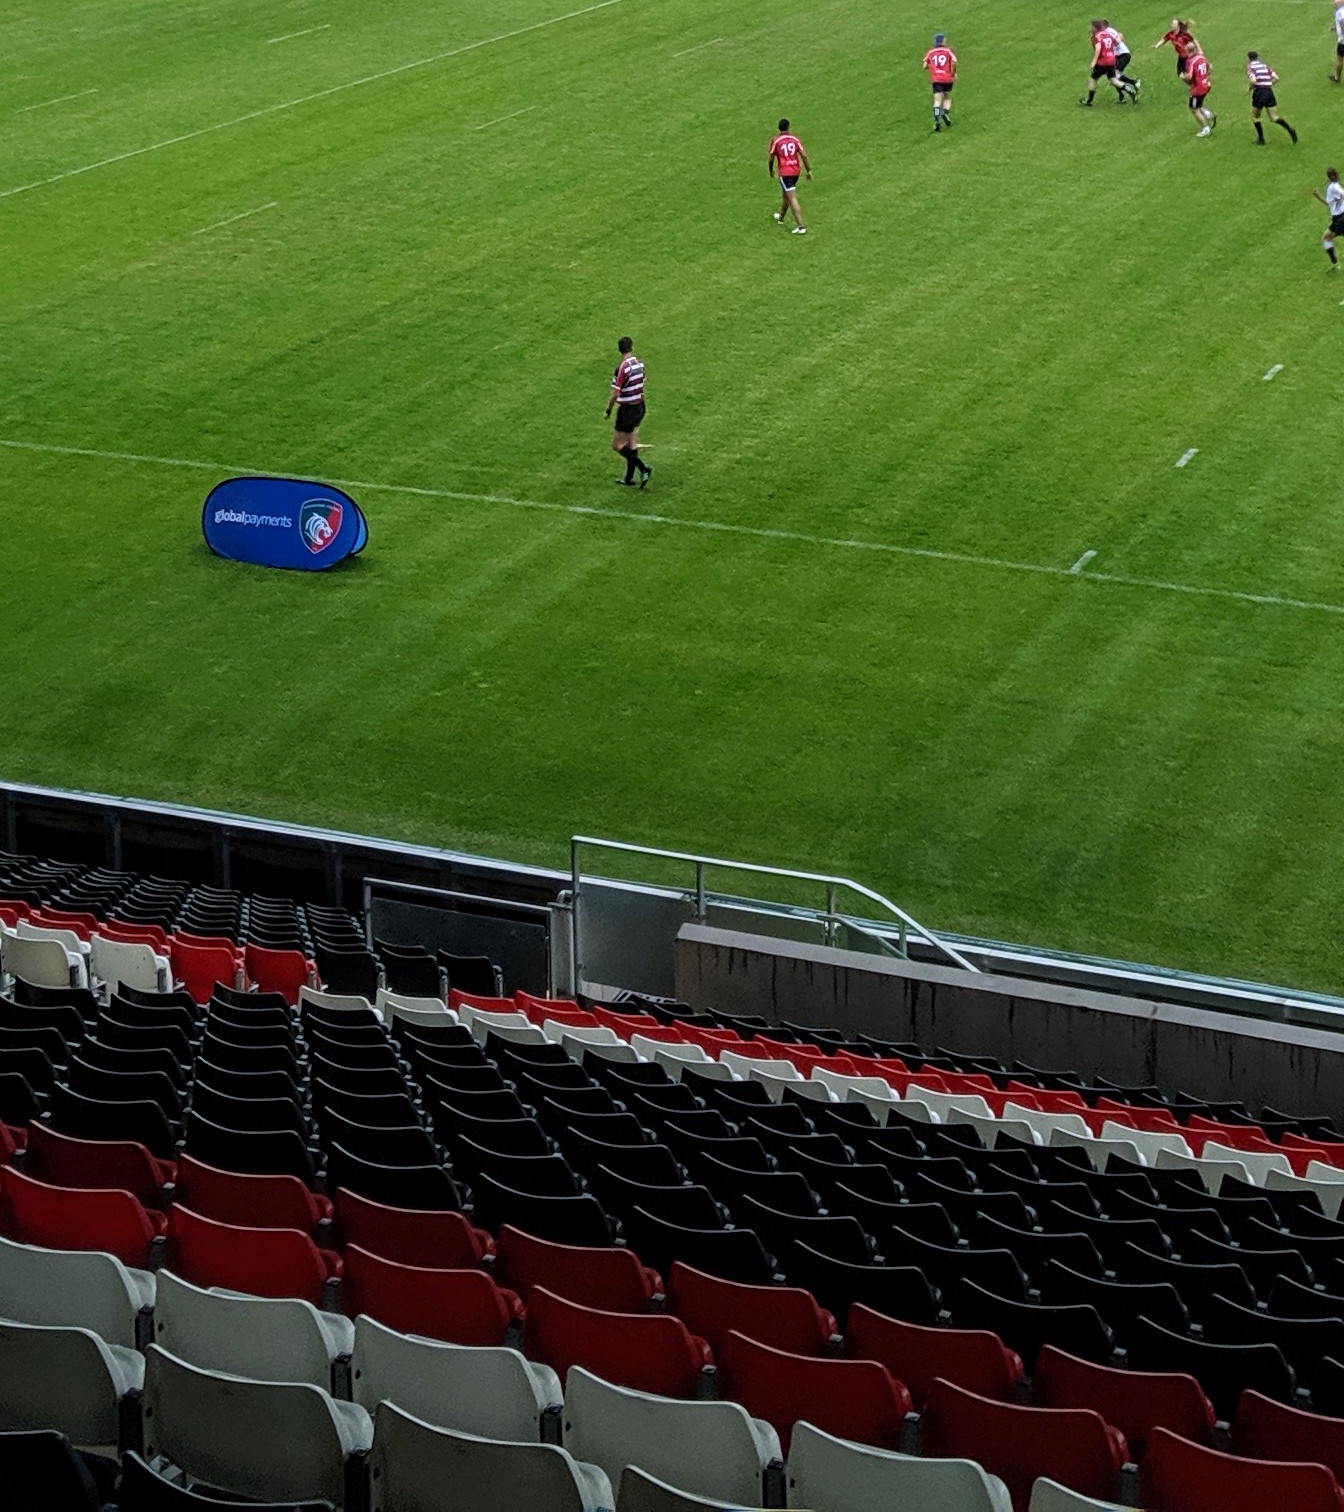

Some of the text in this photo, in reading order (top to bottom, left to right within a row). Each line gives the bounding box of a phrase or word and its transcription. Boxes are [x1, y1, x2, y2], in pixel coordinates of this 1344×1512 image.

[931, 54, 947, 67] 19
[780, 142, 796, 156] 19
[214, 508, 293, 528] globalpayments
